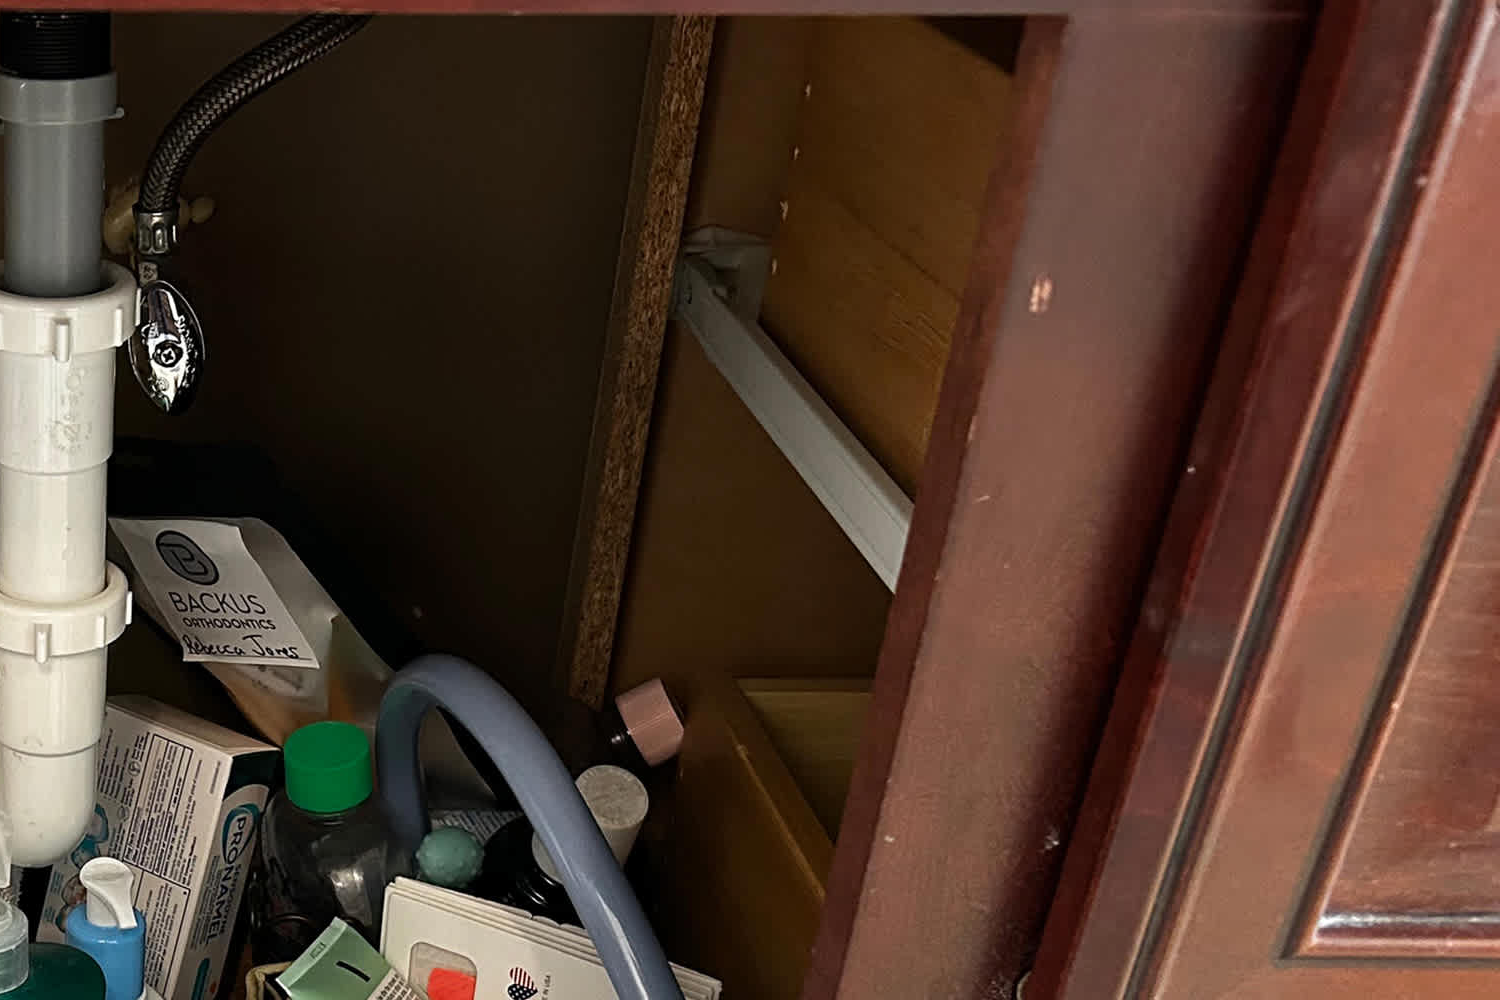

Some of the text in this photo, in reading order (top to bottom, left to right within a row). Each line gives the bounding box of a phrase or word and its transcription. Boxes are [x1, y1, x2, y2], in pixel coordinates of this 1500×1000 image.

[168, 592, 267, 615] BACKUS
[183, 617, 276, 630] ORTHODONTICS
[182, 634, 299, 659] Rebecca Jones
[206, 817, 247, 945] PRONAMEL
